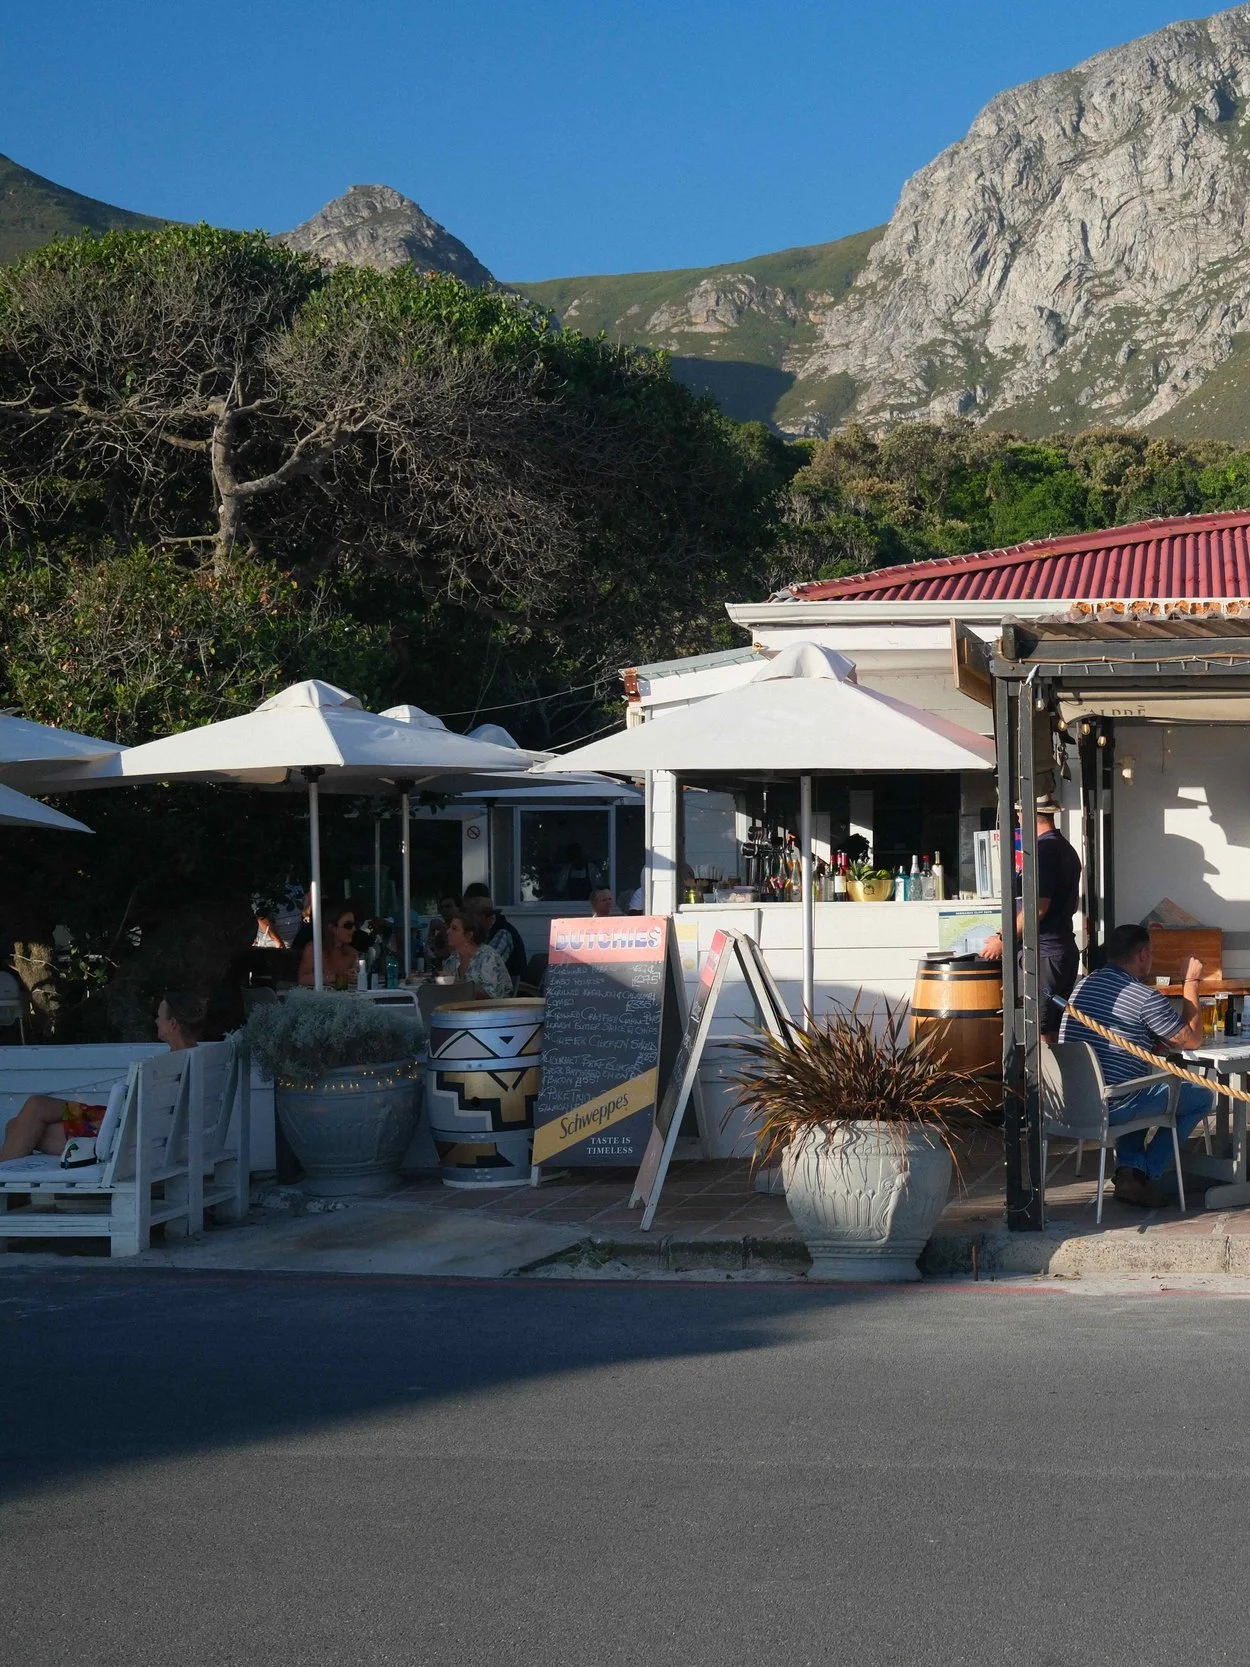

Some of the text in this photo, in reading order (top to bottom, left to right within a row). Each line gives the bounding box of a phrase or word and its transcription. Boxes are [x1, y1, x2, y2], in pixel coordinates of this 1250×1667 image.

[554, 927, 662, 951] DUTCHIES
[551, 1030, 586, 1047] GREEK
[589, 1034, 629, 1052] CHICKEN
[559, 1092, 629, 1139] Schweppes
[586, 1146, 633, 1155] TIMELESS
[590, 1136, 631, 1145] TASTE IS
